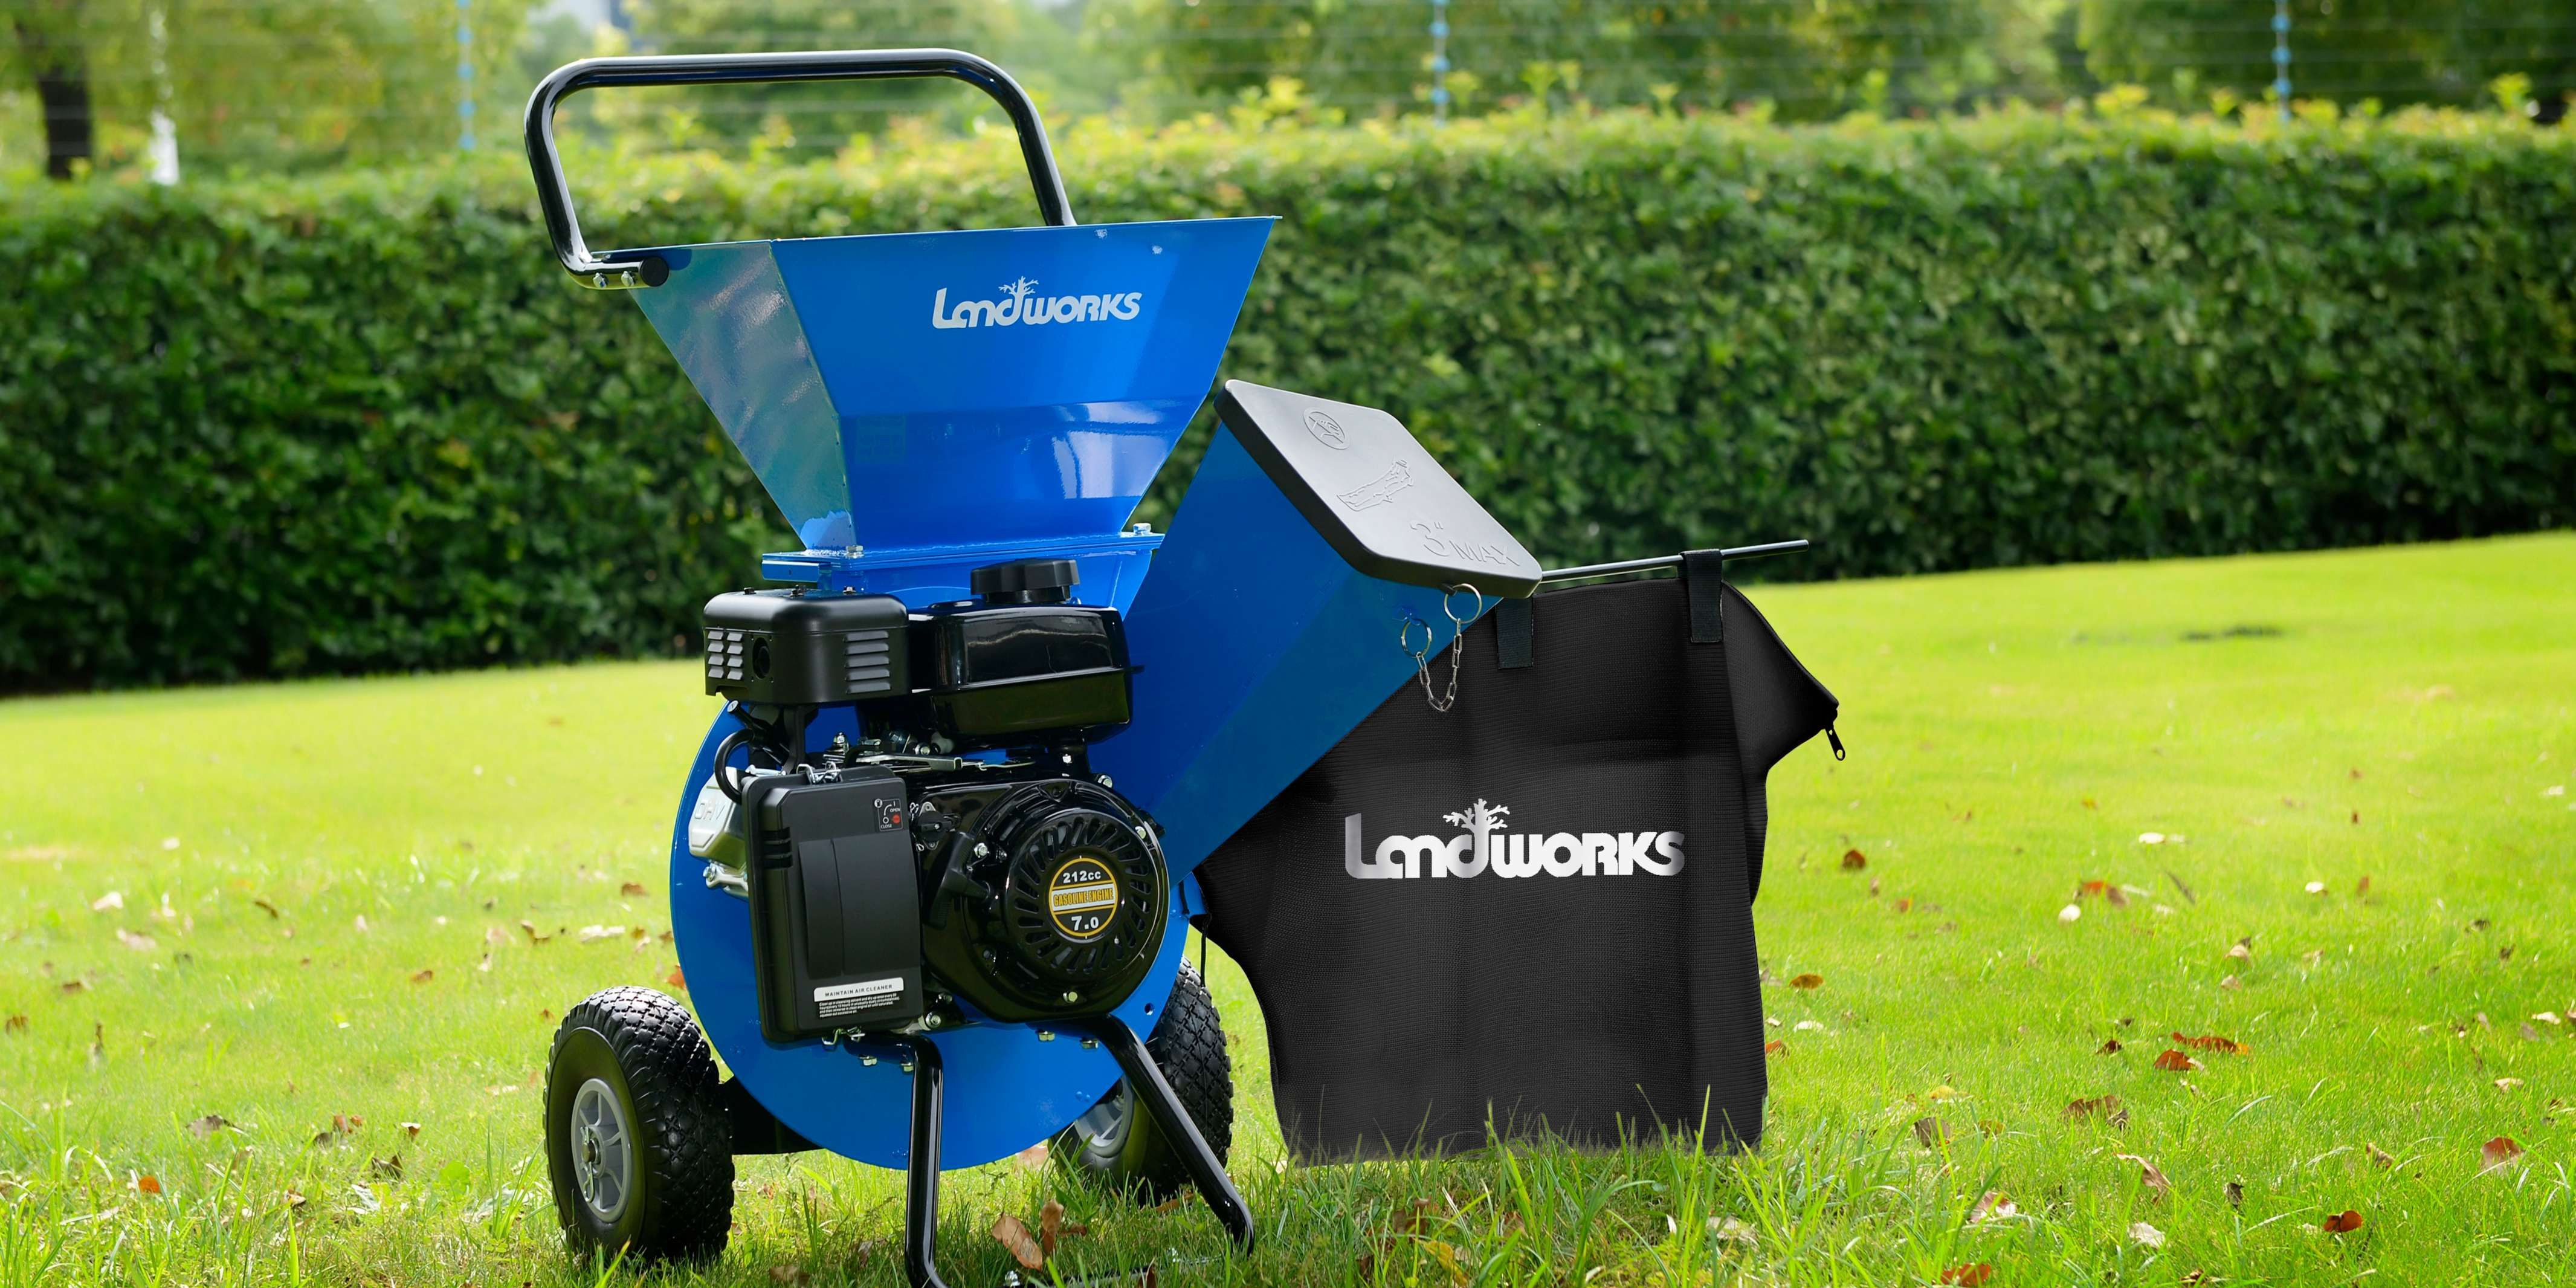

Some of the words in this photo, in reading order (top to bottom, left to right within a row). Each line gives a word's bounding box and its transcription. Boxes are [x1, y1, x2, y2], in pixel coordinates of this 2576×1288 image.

[1448, 540, 1520, 566] MAX
[1063, 870, 1101, 883] 212cc
[1053, 892, 1087, 907] GASOLINE
[1088, 888, 1113, 902] ENGINE
[1071, 916, 1099, 931] 7.0
